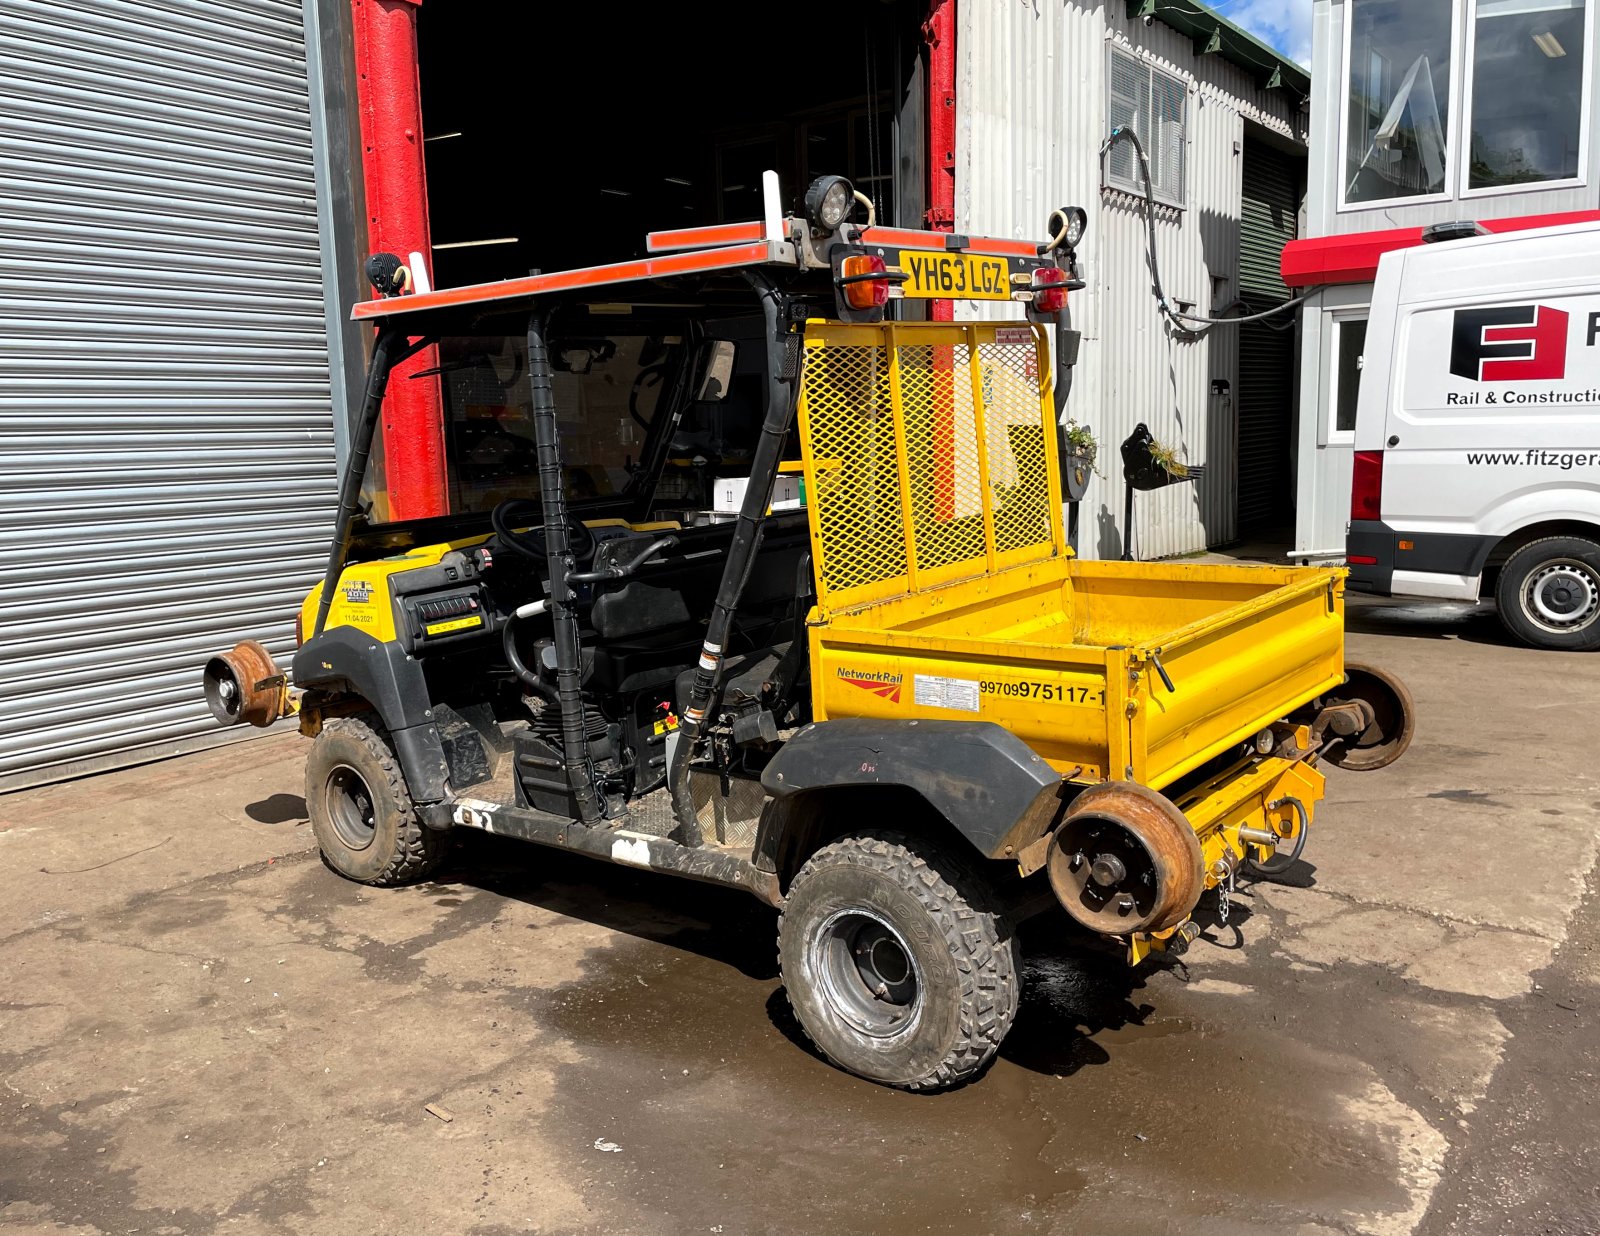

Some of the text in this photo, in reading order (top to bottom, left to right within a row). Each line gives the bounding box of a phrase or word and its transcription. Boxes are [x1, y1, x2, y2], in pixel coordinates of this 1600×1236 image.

[909, 257, 1003, 294] YH63 LGZ
[1446, 391, 1479, 405] Rail
[1485, 391, 1498, 404] &
[1467, 449, 1600, 470] www.fitzger
